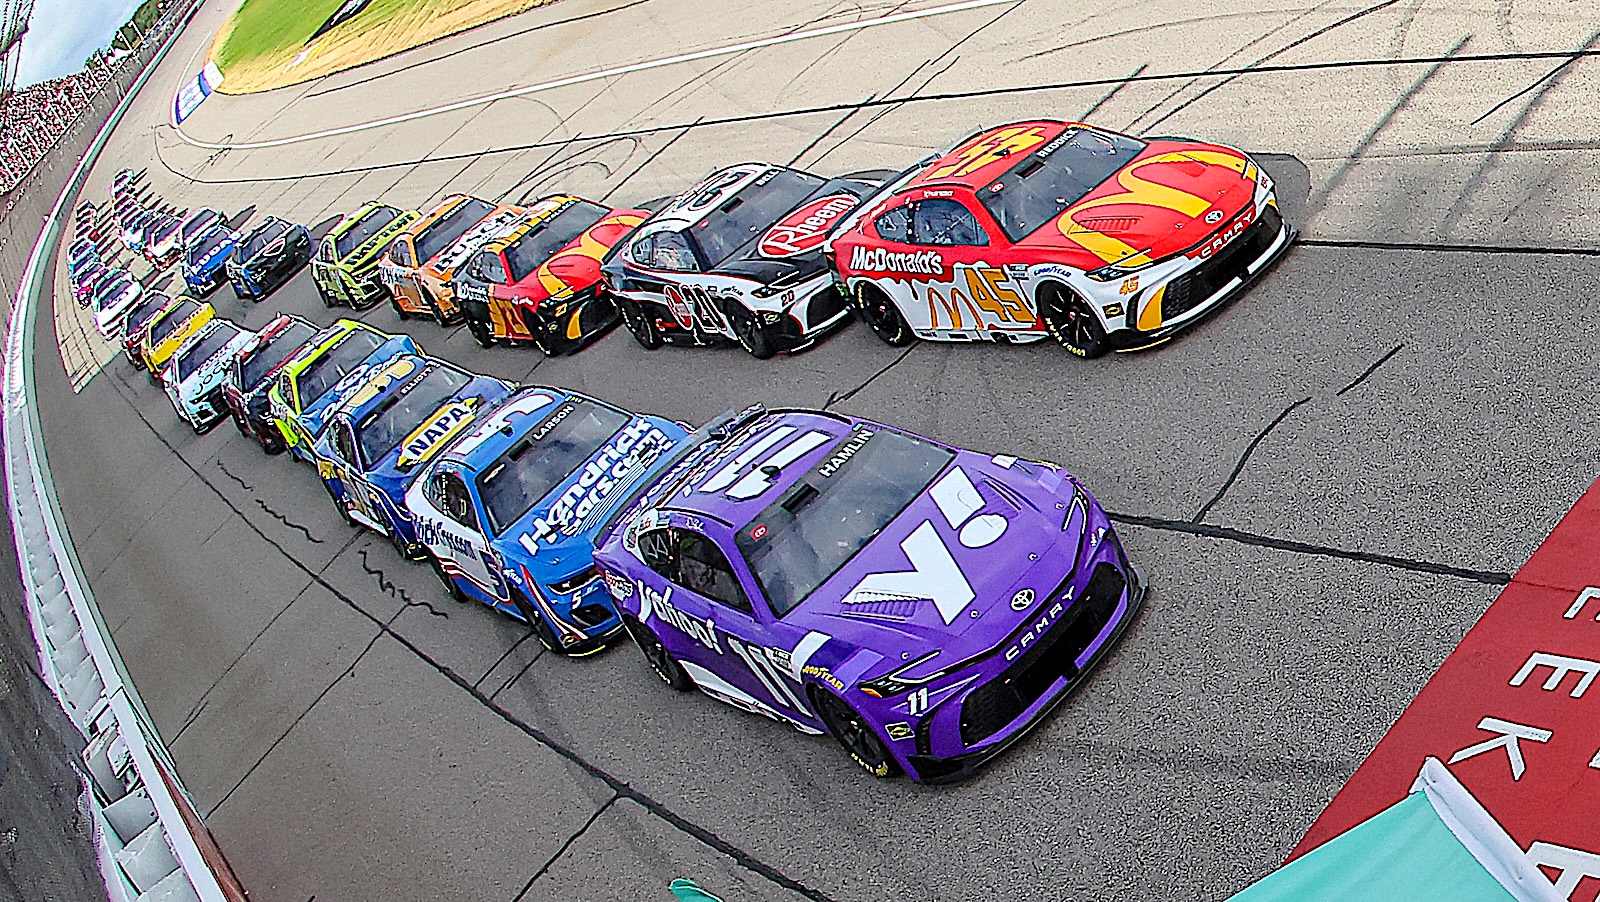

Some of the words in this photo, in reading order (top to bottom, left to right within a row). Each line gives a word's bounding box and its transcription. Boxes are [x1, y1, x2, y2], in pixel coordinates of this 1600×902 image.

[1036, 128, 1080, 158] REDDICK
[762, 199, 855, 252] Rheem
[1201, 211, 1252, 257] CAMRY
[850, 245, 944, 275] McDonald's
[780, 289, 795, 307] 20
[964, 268, 1037, 322] 45
[1119, 275, 1140, 296] 45
[401, 366, 432, 395] ELLIOTT
[407, 407, 470, 457] NAPA
[532, 405, 576, 440] LARSON
[819, 429, 874, 477] HAMLIN
[518, 418, 652, 556] Hendrick
[571, 590, 582, 610] 5
[1005, 585, 1075, 661] CAMRY
[727, 636, 813, 718] 11
[907, 687, 928, 716] 11
